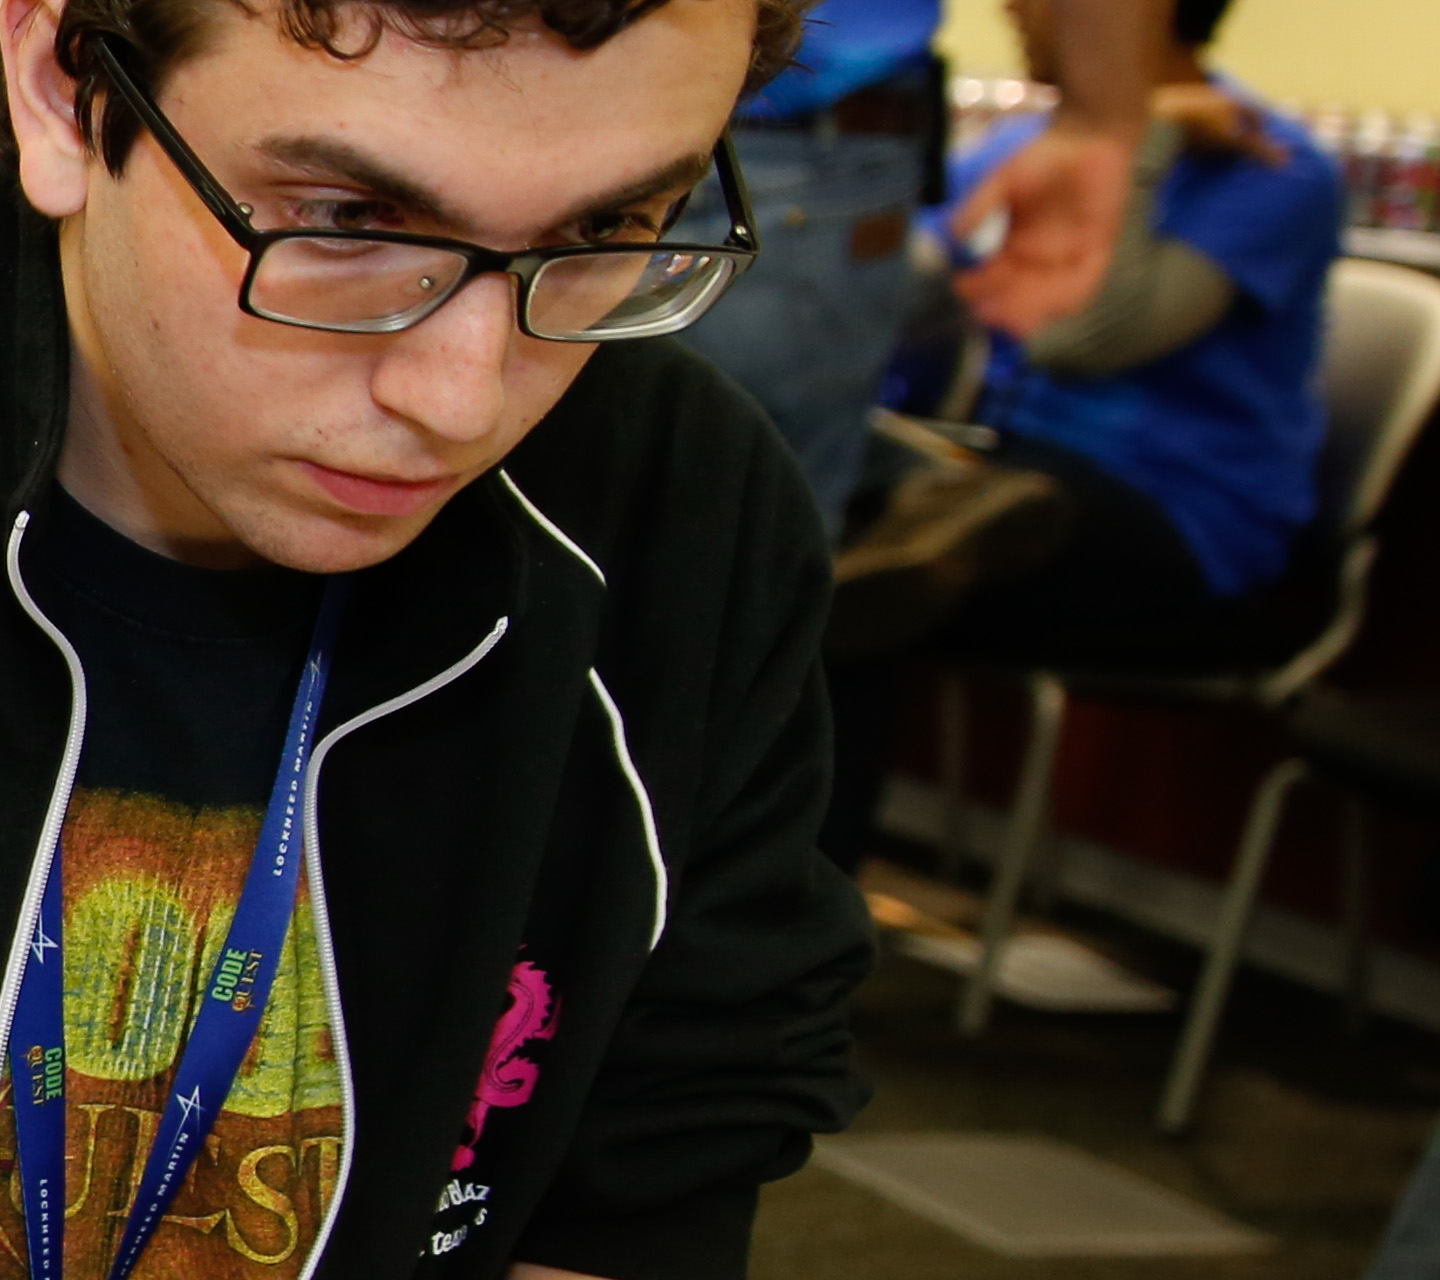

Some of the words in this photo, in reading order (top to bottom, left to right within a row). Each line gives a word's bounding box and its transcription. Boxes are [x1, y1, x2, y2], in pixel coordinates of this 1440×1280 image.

[273, 779, 299, 877] LOCKHEED
[211, 947, 249, 1003] CODE
[43, 1045, 64, 1100] CODE
[156, 1131, 190, 1197] MARTIN
[39, 1178, 51, 1271] LOCKHEED
